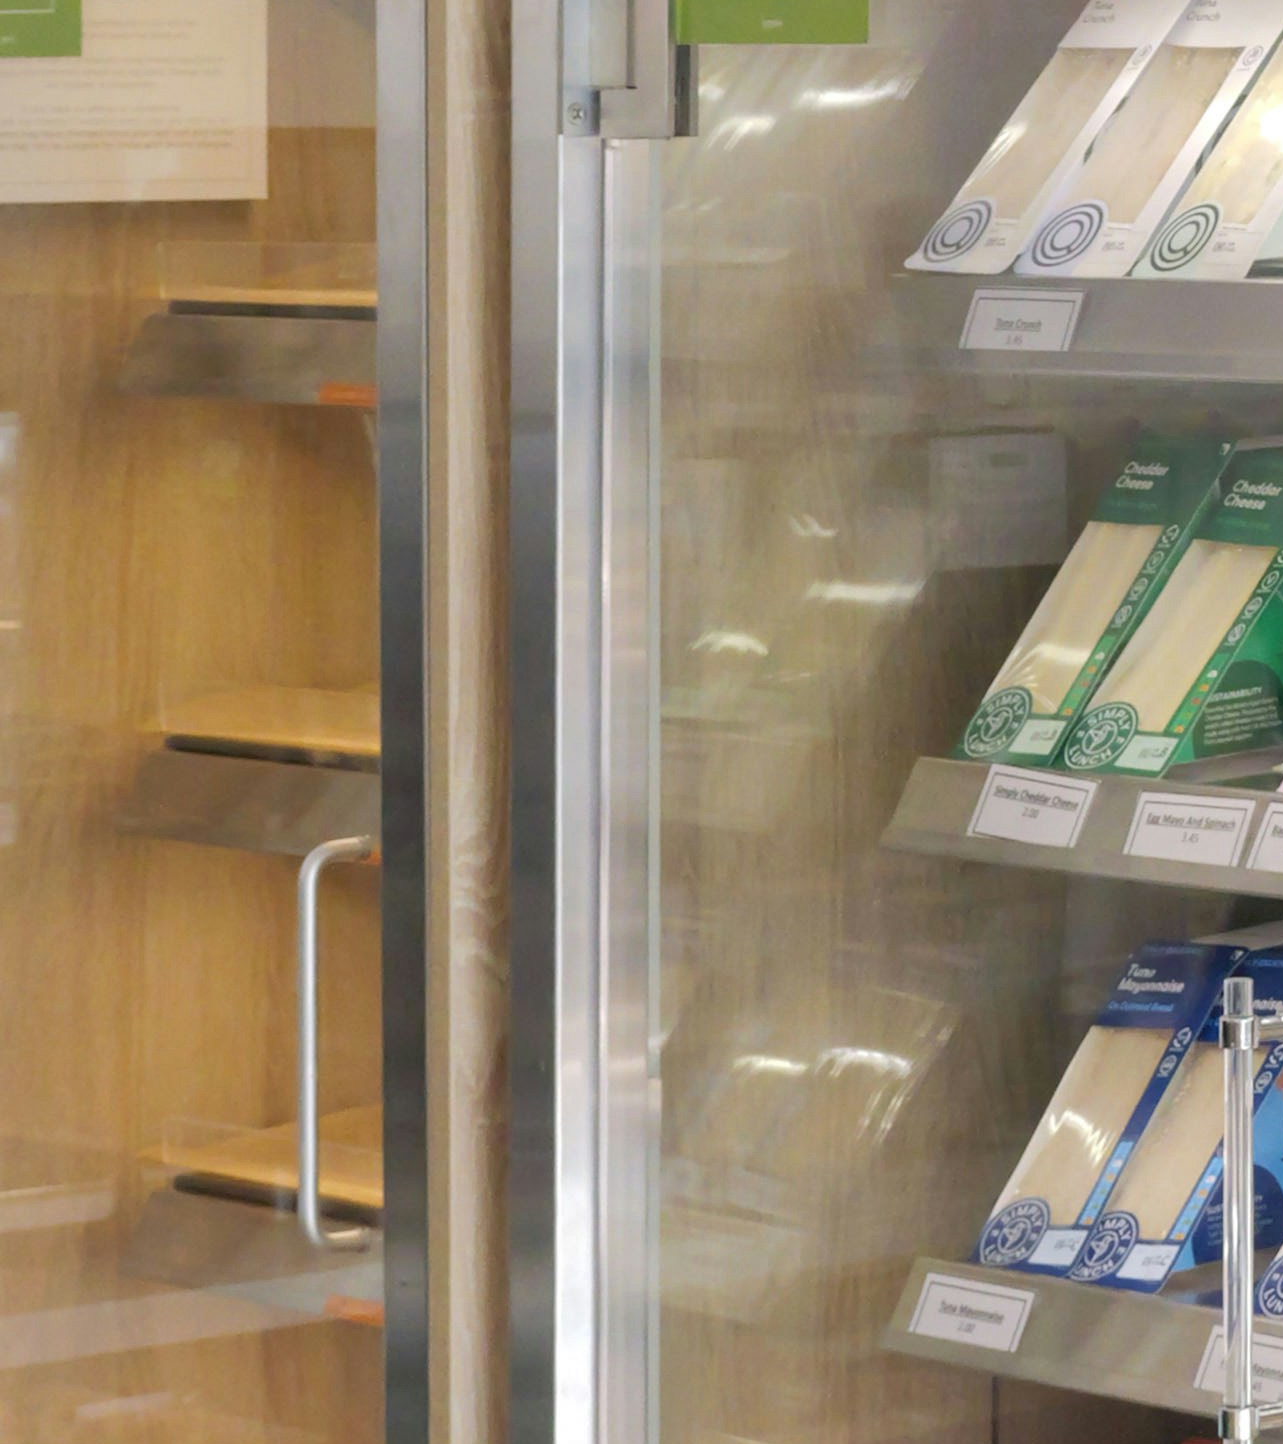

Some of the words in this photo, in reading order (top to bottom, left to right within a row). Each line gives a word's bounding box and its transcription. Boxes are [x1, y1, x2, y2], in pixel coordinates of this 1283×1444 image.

[1124, 461, 1170, 477] Cheddar
[1115, 476, 1154, 491] Cheese
[1232, 479, 1283, 497] Cheddar
[1223, 493, 1267, 511] Cheese
[985, 687, 1027, 716] SIMPLY
[1087, 704, 1133, 737] SIMPLY
[1069, 744, 1114, 769] LUNCH
[994, 785, 1021, 802] Simply
[1021, 789, 1051, 805] Cheddar
[1051, 794, 1080, 810] Cheese
[1116, 977, 1185, 995] Mayonnaise
[1001, 1200, 1046, 1238] SIMPLY
